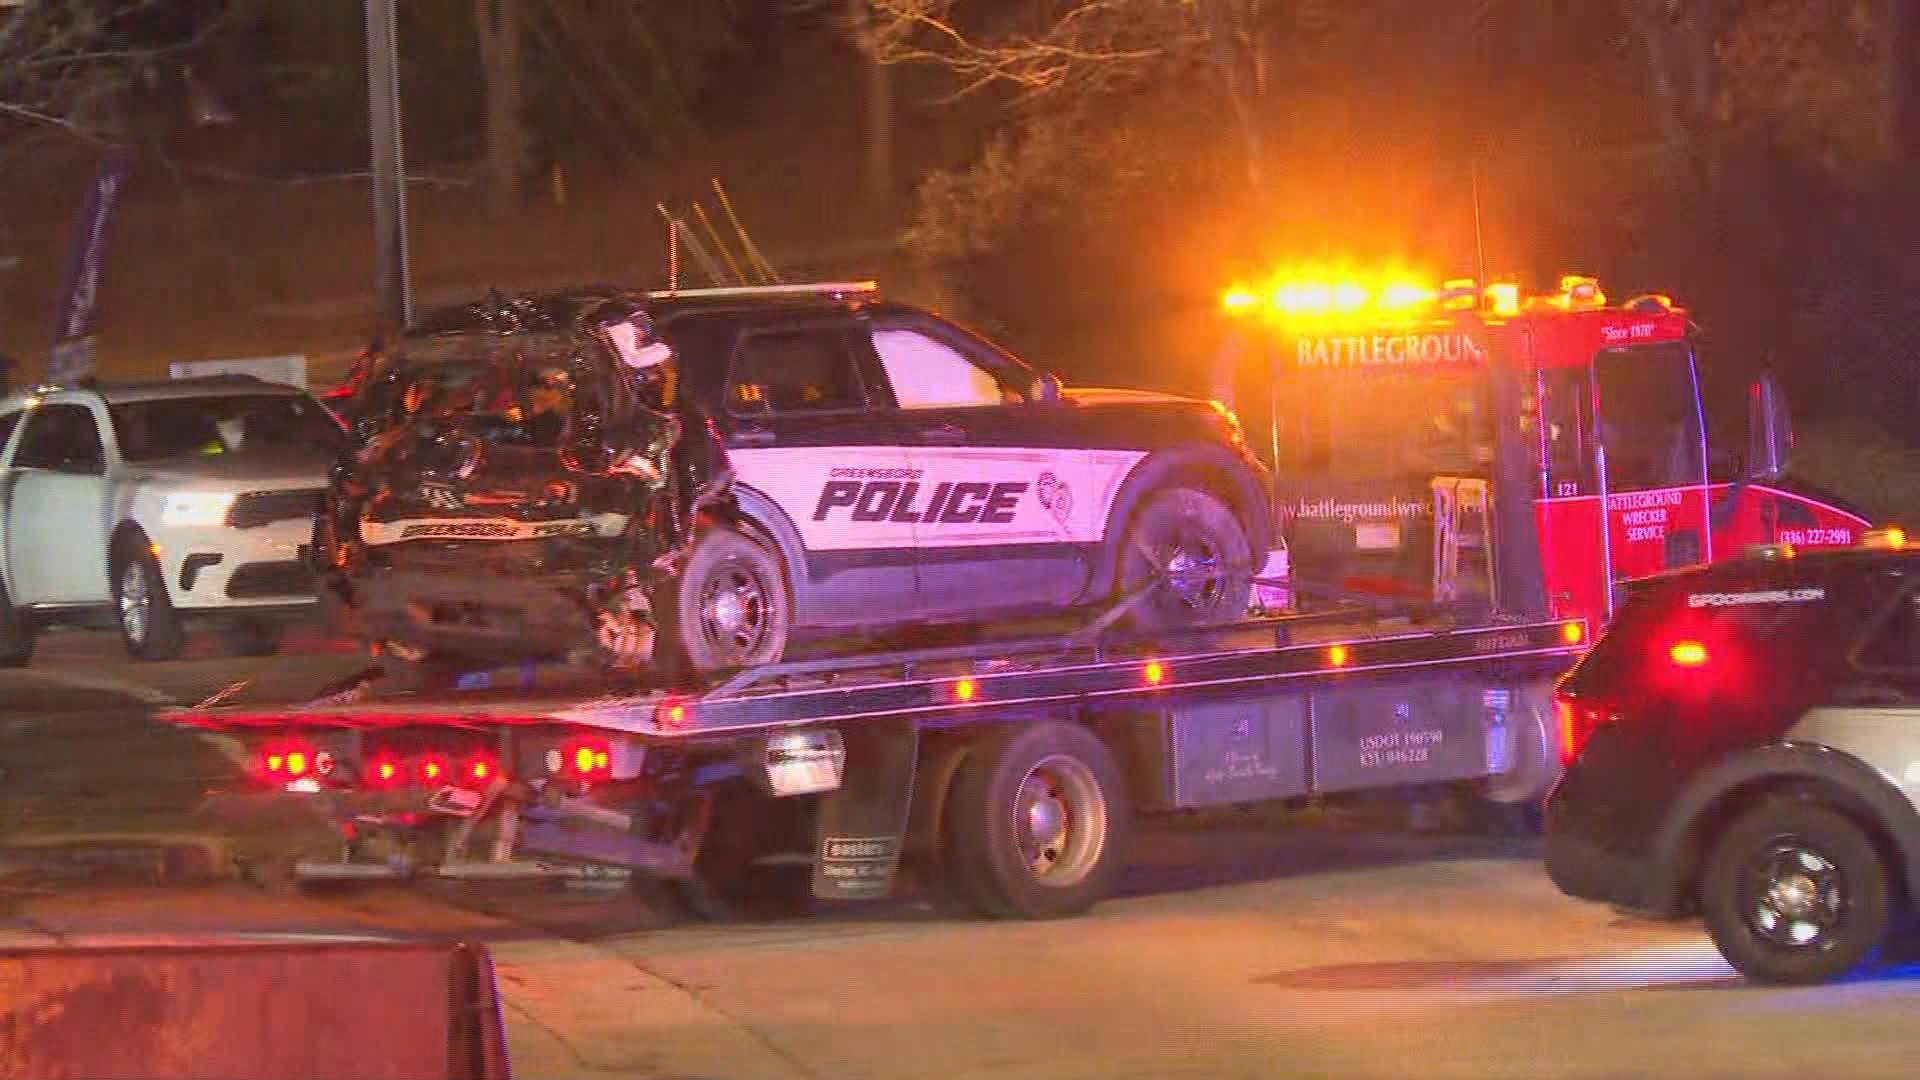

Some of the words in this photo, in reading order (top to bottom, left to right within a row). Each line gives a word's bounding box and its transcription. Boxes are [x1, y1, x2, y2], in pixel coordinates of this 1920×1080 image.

[1298, 335, 1485, 367] BATTLEGROUN
[1558, 482, 1578, 497] 121
[811, 480, 1031, 524] POLICE
[1622, 508, 1668, 526] WRECKER
[1626, 525, 1665, 543] SERVICE
[1807, 527, 1852, 545] 227-2991
